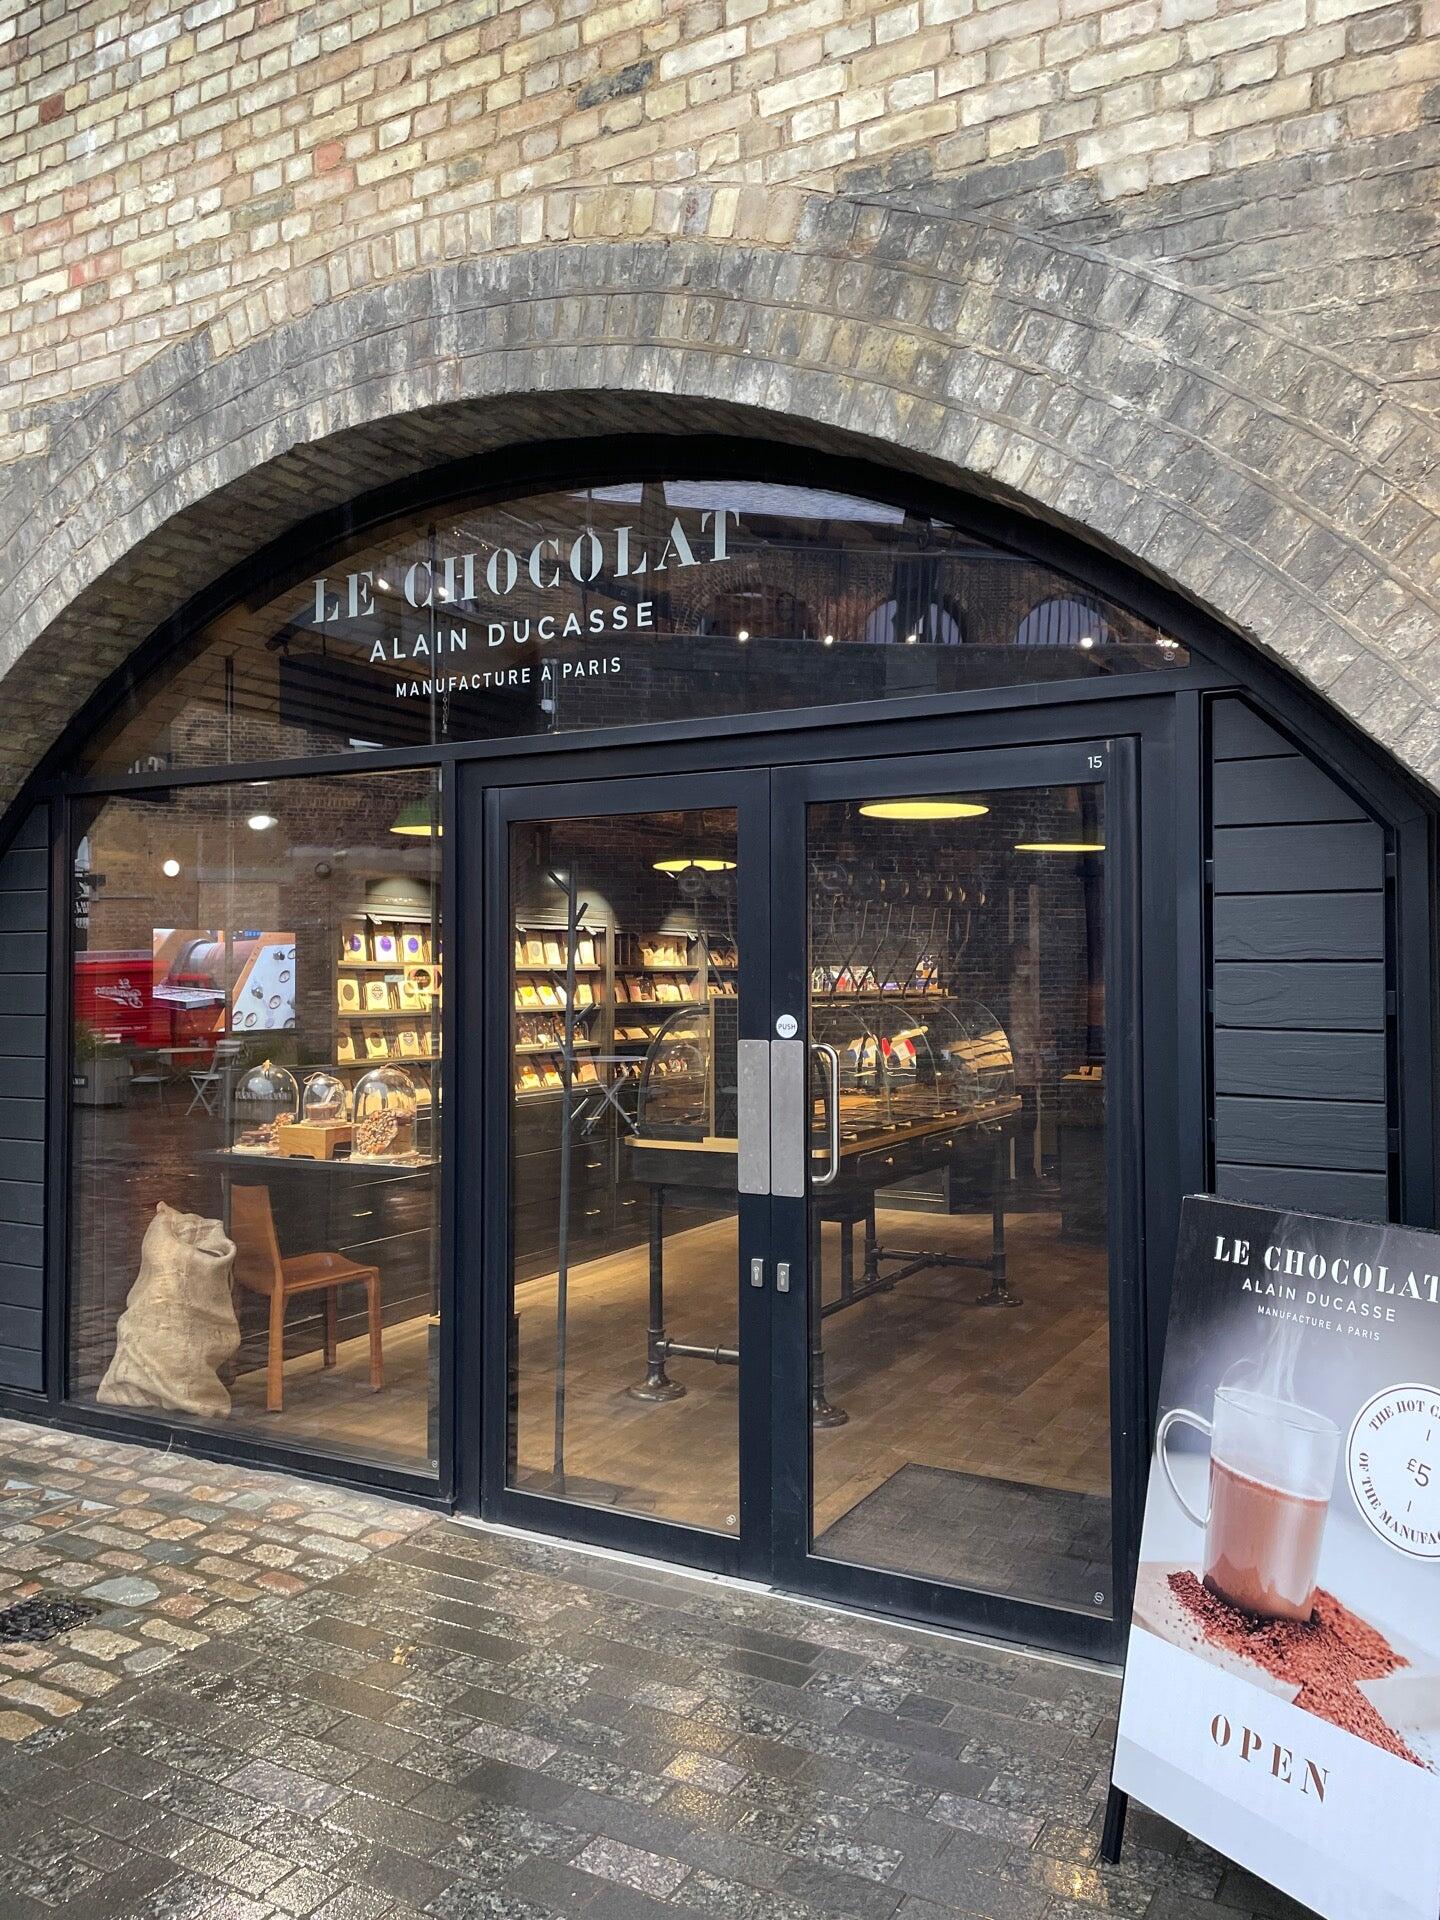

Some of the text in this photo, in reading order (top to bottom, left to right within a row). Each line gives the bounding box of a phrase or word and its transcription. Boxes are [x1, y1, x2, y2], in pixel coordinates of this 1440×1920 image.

[312, 508, 741, 623] LE CHOCOLAT
[369, 601, 654, 662] ALAIN DUCASSE
[396, 657, 622, 698] MANUFACTURE A PARIS
[1087, 755, 1103, 769] 15
[1213, 1236, 1439, 1303] LE CHOCOLAT
[1242, 1278, 1396, 1323] ALAIN DUCASSE
[1257, 1305, 1380, 1341] MANUFACTURE A PARIS
[1369, 1405, 1394, 1431] THE
[1396, 1400, 1425, 1413] HOT
[1359, 1452, 1369, 1472] OF
[1406, 1458, 1431, 1487] £5
[1362, 1476, 1381, 1510] THE
[1211, 1714, 1330, 1803] OPEN
